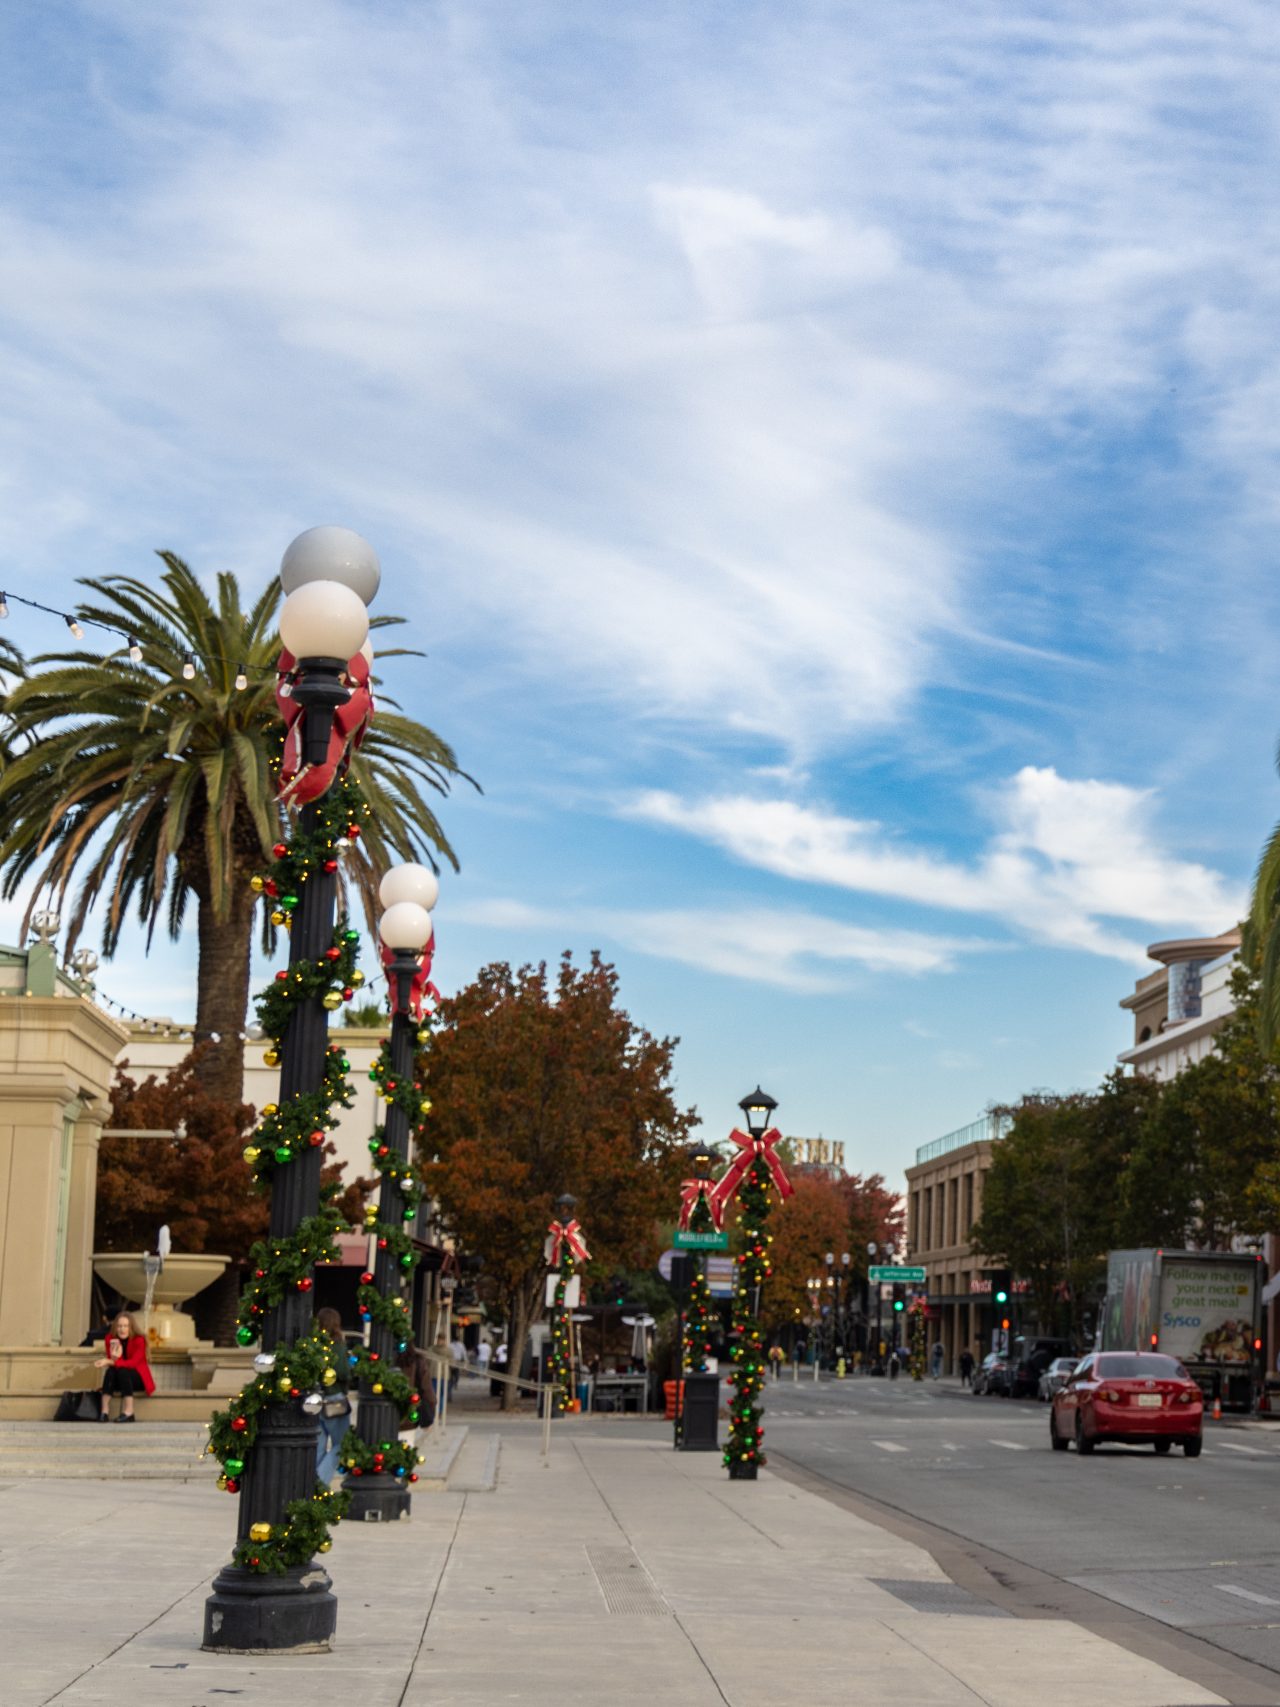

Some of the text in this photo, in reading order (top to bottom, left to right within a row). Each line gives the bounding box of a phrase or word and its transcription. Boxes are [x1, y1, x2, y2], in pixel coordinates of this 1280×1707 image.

[1166, 1267, 1247, 1282] Follow me to
[1176, 1284, 1236, 1295] your next
[1172, 1296, 1239, 1308] great meal
[1163, 1312, 1201, 1328] Sysco
